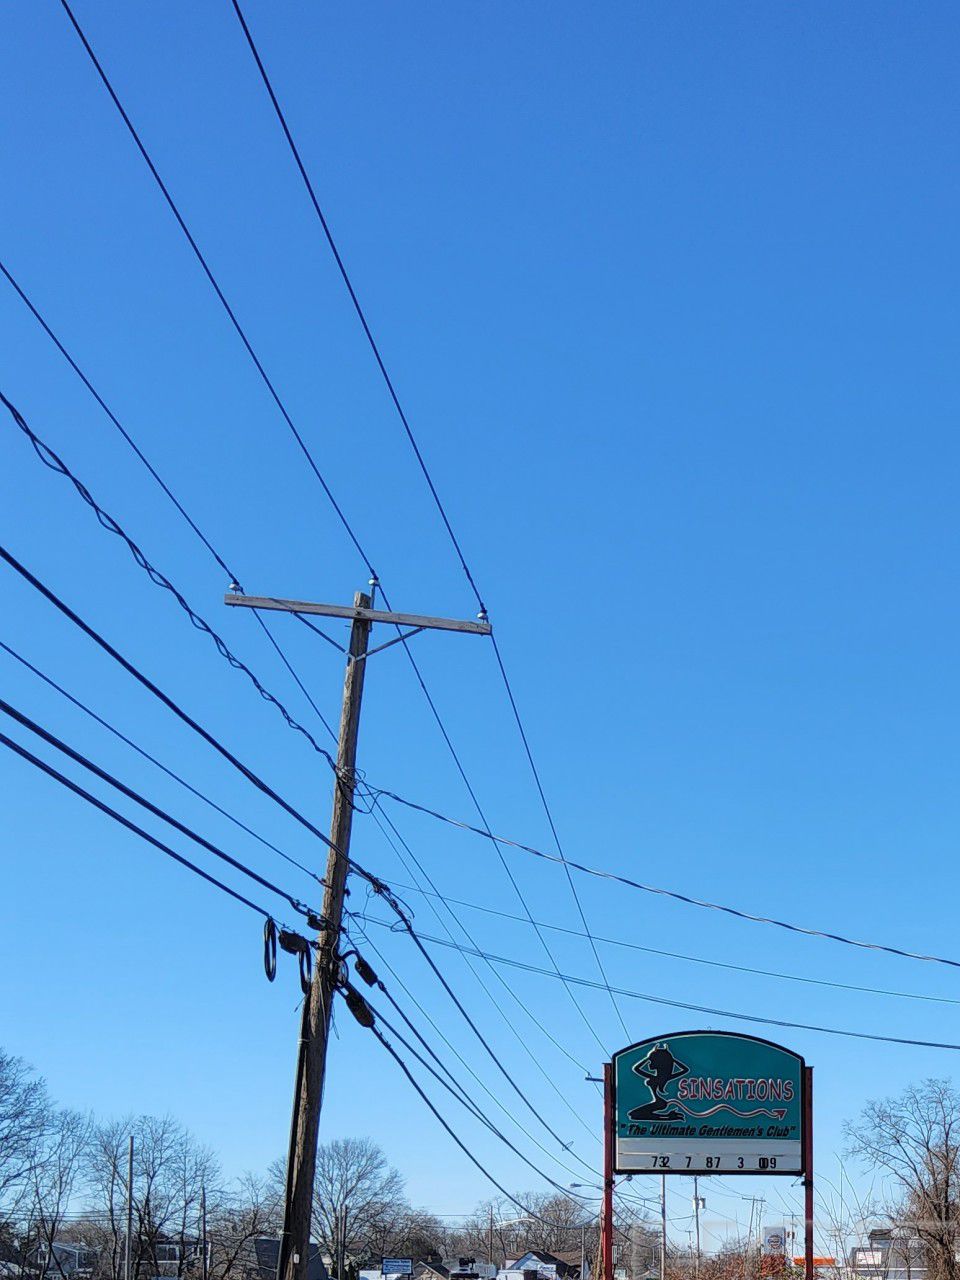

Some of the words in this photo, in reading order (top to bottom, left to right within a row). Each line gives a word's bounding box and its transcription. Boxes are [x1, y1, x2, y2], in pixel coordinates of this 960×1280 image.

[678, 1077, 794, 1102] SINSATIONS
[650, 1122, 696, 1136] Ultimate
[698, 1124, 764, 1137] Gentlemen's
